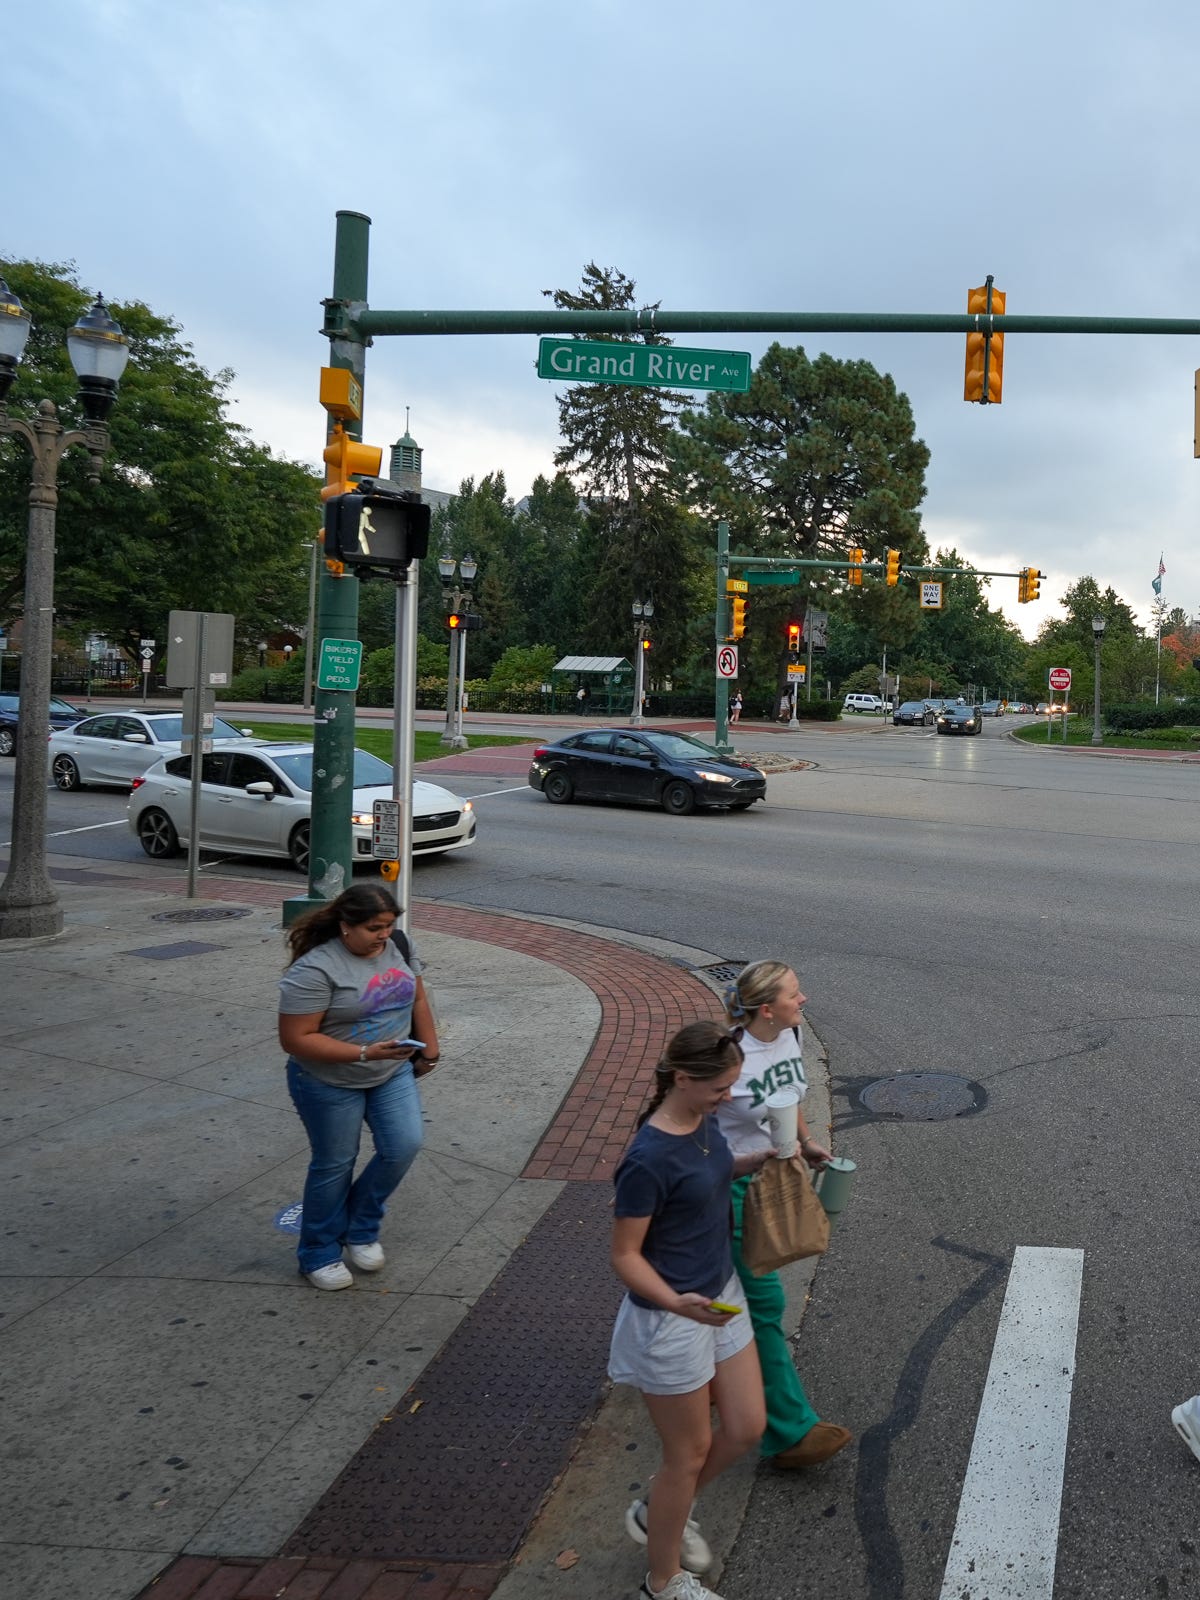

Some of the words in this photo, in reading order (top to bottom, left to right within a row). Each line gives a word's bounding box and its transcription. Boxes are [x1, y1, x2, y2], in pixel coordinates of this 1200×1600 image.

[550, 346, 634, 377] Grand
[647, 352, 715, 382] River
[721, 366, 739, 377] Ave
[325, 645, 358, 655] BIKERS
[327, 655, 354, 664] YIELD
[333, 665, 346, 673] TO
[326, 675, 351, 684] PEDS
